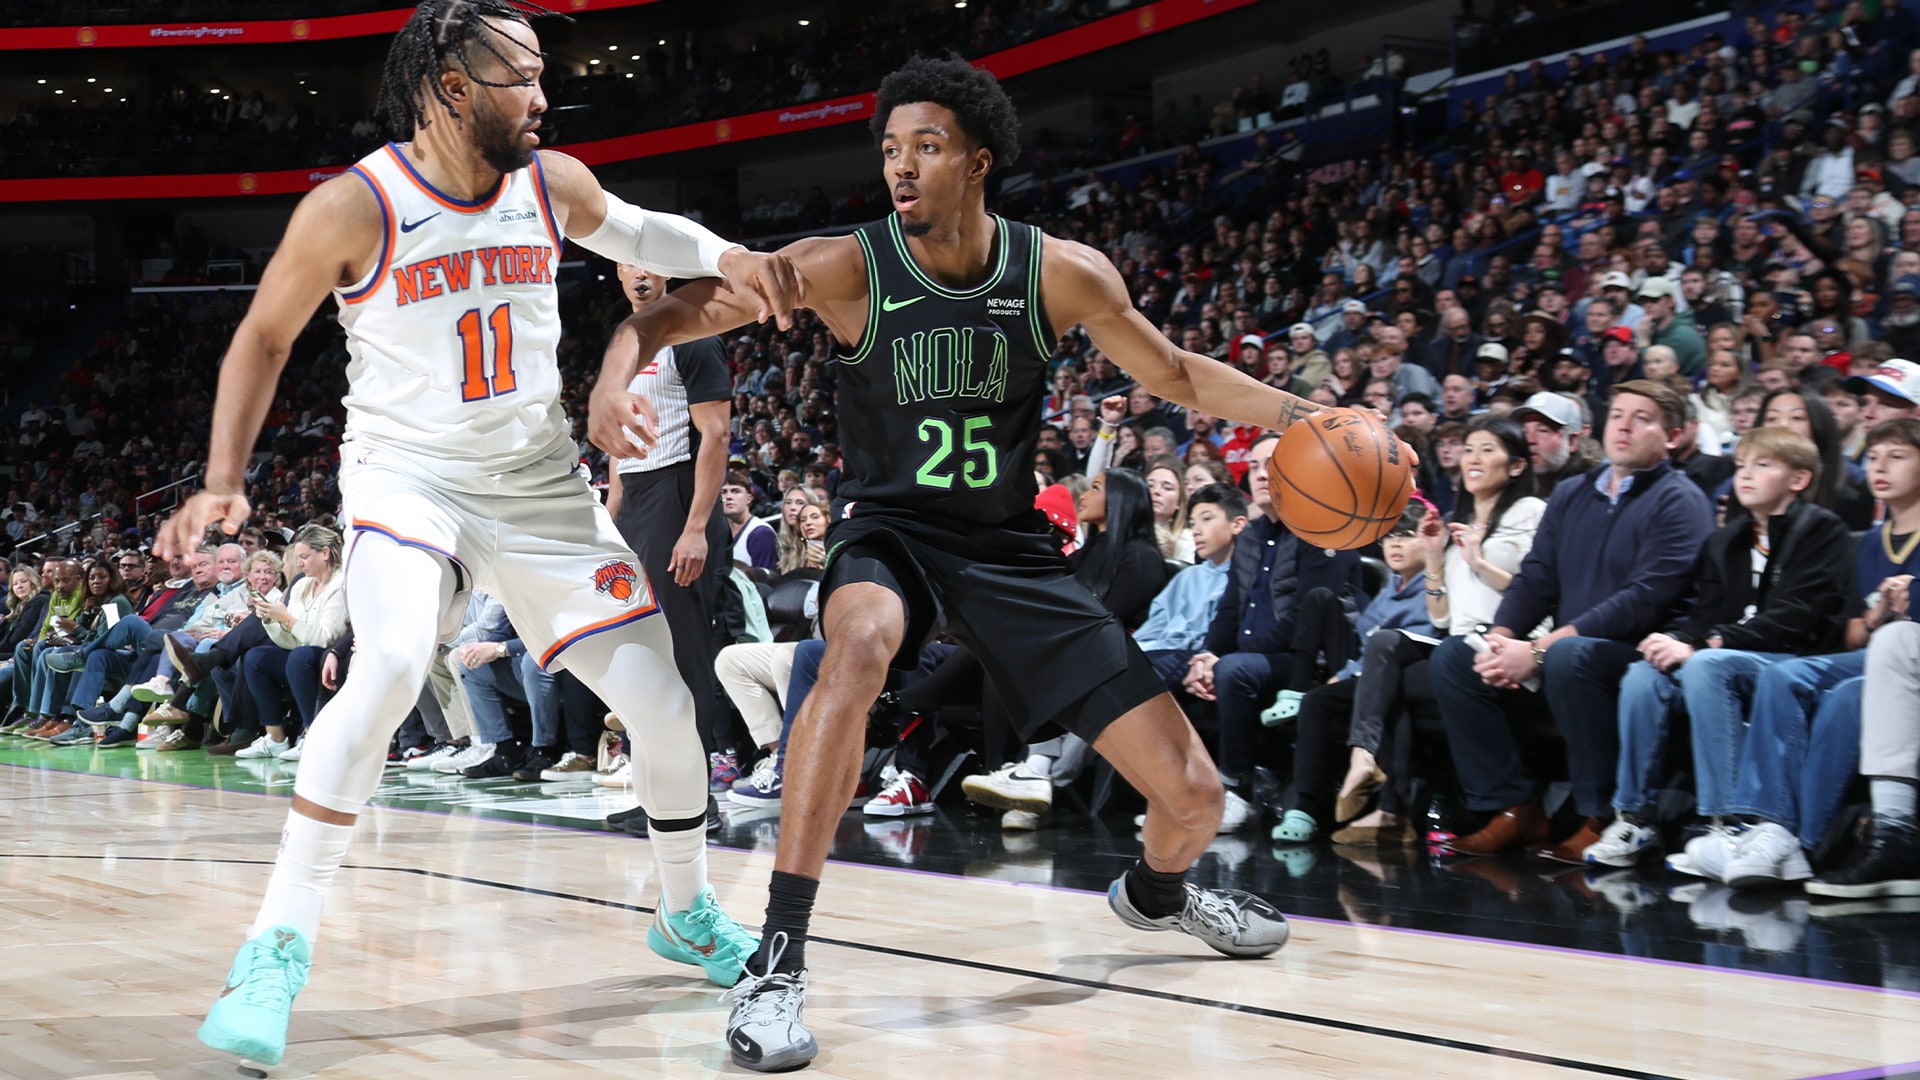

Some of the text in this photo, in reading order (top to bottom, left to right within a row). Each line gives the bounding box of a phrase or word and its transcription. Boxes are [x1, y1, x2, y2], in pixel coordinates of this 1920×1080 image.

[150, 26, 244, 38] #PoweringProgress
[393, 245, 553, 307] NEW YORK
[986, 298, 1025, 309] NEWAGE
[456, 302, 517, 403] 11
[892, 327, 1009, 405] NOLA
[915, 415, 998, 490] 25
[595, 561, 637, 591] KNICKS
